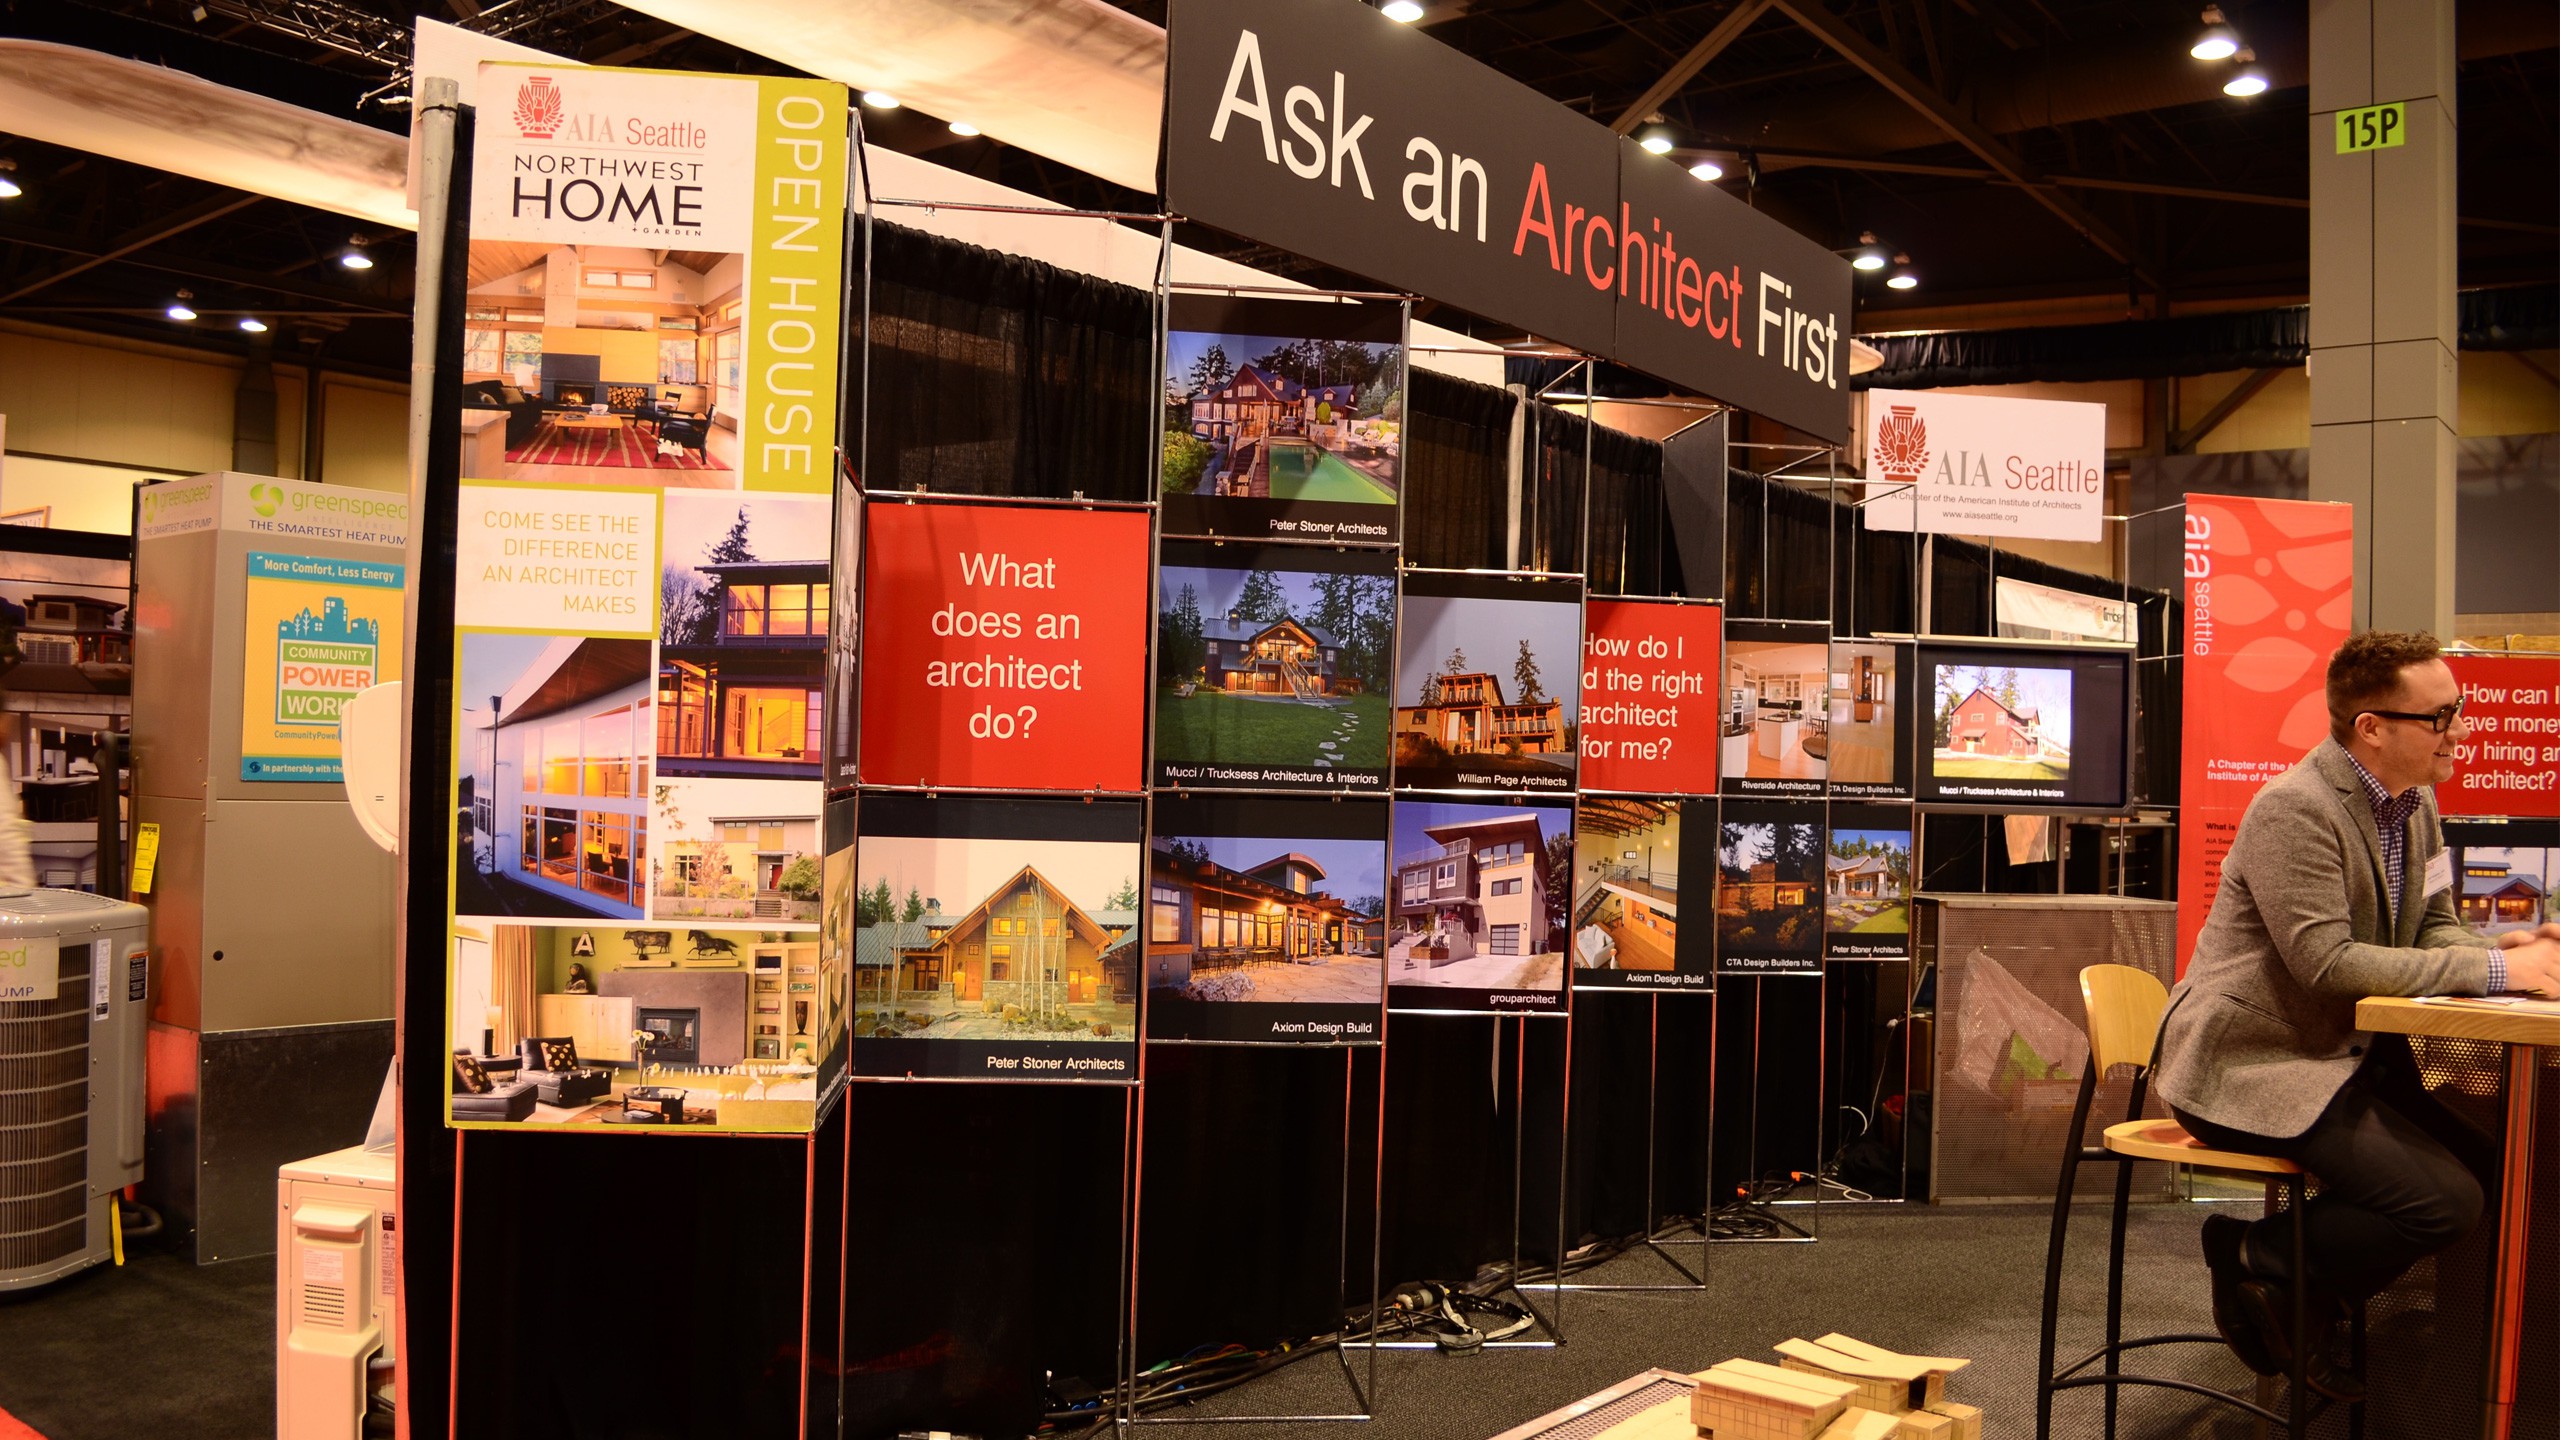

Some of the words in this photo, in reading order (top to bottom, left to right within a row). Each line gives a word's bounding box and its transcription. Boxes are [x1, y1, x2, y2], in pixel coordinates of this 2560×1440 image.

[566, 113, 615, 143] AIA
[626, 117, 706, 149] Seattle
[2343, 107, 2398, 148] 15P
[514, 154, 703, 181] NORTHWEST
[771, 95, 825, 252] OPEN
[513, 176, 703, 227] HOME
[1209, 28, 1375, 201] Ask
[1401, 135, 1487, 242] an
[1513, 161, 1743, 349] Architect
[1758, 271, 1837, 389] First
[643, 227, 701, 236] GARDEN
[763, 276, 817, 475] HOUSE
[1934, 450, 1992, 488] AIA
[2005, 455, 2098, 494] Seattle
[160, 484, 211, 512] greenspeed
[1899, 492, 1930, 502] Chapter
[1933, 494, 1942, 502] of
[1943, 495, 1956, 503] the
[1958, 496, 1997, 505] American
[1999, 498, 2030, 507] Institute
[2032, 500, 2040, 508] of
[2042, 500, 2082, 510] Architects
[484, 511, 544, 530] COME
[552, 514, 591, 531] SEE
[598, 515, 639, 534] THE
[1942, 510, 2018, 523] www.aiaseattle.org
[249, 519, 273, 531] THE
[278, 522, 342, 539] SMARTEST
[346, 530, 376, 542] HEAT
[380, 534, 406, 545] PUM
[1270, 519, 1297, 531] Peter
[1300, 520, 1334, 532] Stoner
[1336, 522, 1388, 536] Architects
[504, 538, 638, 560] DIFFERENCE
[264, 559, 289, 572] More
[292, 562, 335, 577] Comfort,
[338, 566, 359, 578] Less
[362, 568, 395, 583] Energy
[482, 565, 512, 582] AN
[519, 566, 638, 587] ARCHITECT
[959, 552, 1056, 589] What
[564, 595, 636, 614] MAKES
[931, 602, 1022, 638] does
[1035, 613, 1080, 640] an
[2194, 581, 2213, 656] seattle
[289, 646, 368, 662] COMMUNITY
[1584, 632, 1630, 656] How
[1638, 635, 1668, 658] do
[1678, 636, 1682, 659] I
[283, 666, 371, 688] POWER
[926, 654, 1082, 690] architect
[1606, 667, 1643, 692] the
[1652, 669, 1702, 698] right
[2462, 683, 2506, 703] How
[2512, 688, 2547, 704] can
[2555, 686, 2560, 704] I
[968, 704, 1038, 738] do?
[1581, 702, 1678, 727] architect
[2461, 716, 2498, 732] ave
[1580, 734, 1612, 758] for
[1621, 737, 1672, 760] me?
[2454, 741, 2477, 765] by
[2484, 741, 2536, 766] hiring
[262, 764, 270, 772] In
[272, 764, 314, 774] partnership
[316, 764, 331, 773] with
[1166, 766, 1197, 778] Mucci
[1200, 768, 1204, 778] /
[1207, 768, 1259, 780] Trucksess
[1262, 770, 1323, 782] Architecture
[1326, 772, 1334, 782] &
[1338, 772, 1378, 784] Interiors
[2208, 759, 2216, 768] A
[2217, 760, 2256, 771] Chapter
[2258, 762, 2268, 770] of
[2270, 762, 2286, 771] the
[1458, 774, 1492, 784] William
[1494, 774, 1518, 786] Page
[1520, 776, 1568, 786] Architects
[1742, 780, 1776, 790] Riverside
[1777, 782, 1820, 791] Architecture
[2207, 771, 2247, 781] Institute
[2250, 772, 2260, 782] of
[2462, 770, 2556, 790] architect?
[1842, 785, 1866, 794] Design
[1867, 786, 1893, 794] Builders
[1894, 786, 1906, 794] Inc.
[1940, 786, 1958, 794] Mucci
[1963, 786, 1994, 796] Trucksess
[1995, 788, 2032, 797] Architecture
[2032, 789, 2038, 797] &
[2039, 789, 2064, 798] Interiors
[2206, 822, 2226, 830] What
[1850, 946, 1872, 954] Stoner
[1872, 946, 1903, 954] Architects
[1726, 958, 1742, 966] CTA
[1744, 958, 1765, 968] Design
[1770, 958, 1800, 967] Builders
[1802, 959, 1815, 967] Inc.
[1626, 974, 1652, 982] Axiom
[1654, 974, 1682, 985] Design
[1684, 974, 1704, 984] Build
[0, 986, 34, 998] UMP
[1490, 994, 1556, 1005] grouparchitect
[1272, 1022, 1304, 1032] Axiom
[1308, 1022, 1344, 1036] Design
[1346, 1022, 1372, 1033] Build
[988, 1056, 1019, 1068] Peter
[1022, 1056, 1062, 1069] Stoner
[1066, 1058, 1125, 1070] Architects
